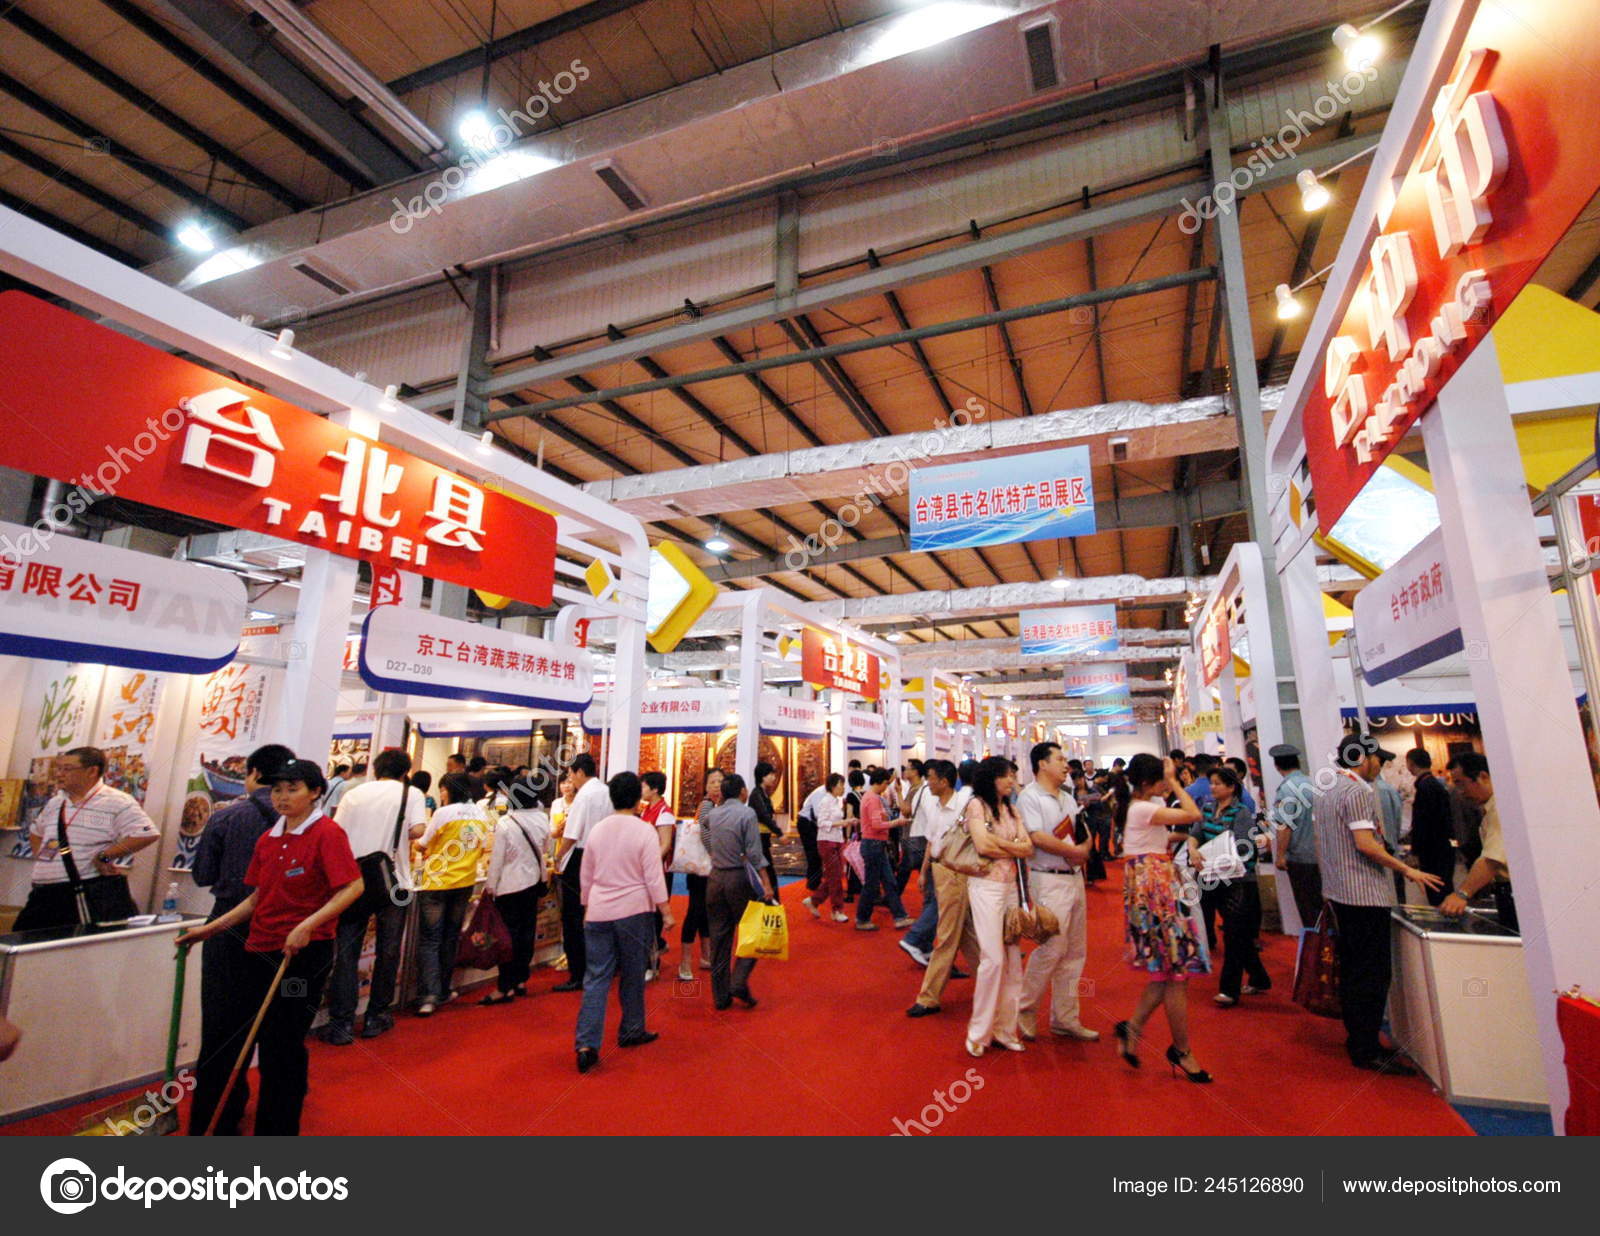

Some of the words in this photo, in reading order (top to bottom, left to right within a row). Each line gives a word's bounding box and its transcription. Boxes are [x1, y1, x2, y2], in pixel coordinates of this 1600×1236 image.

[1325, 48, 1509, 450] 台中市
[180, 387, 487, 552] 台北县
[916, 477, 1086, 523] 台湾县市名优特产品展区
[262, 497, 428, 567] TAIBEI
[1391, 561, 1443, 624] 台中市政府
[386, 659, 433, 676] D27-D30
[417, 633, 576, 681] 京工台湾蔬菜汤养生馆
